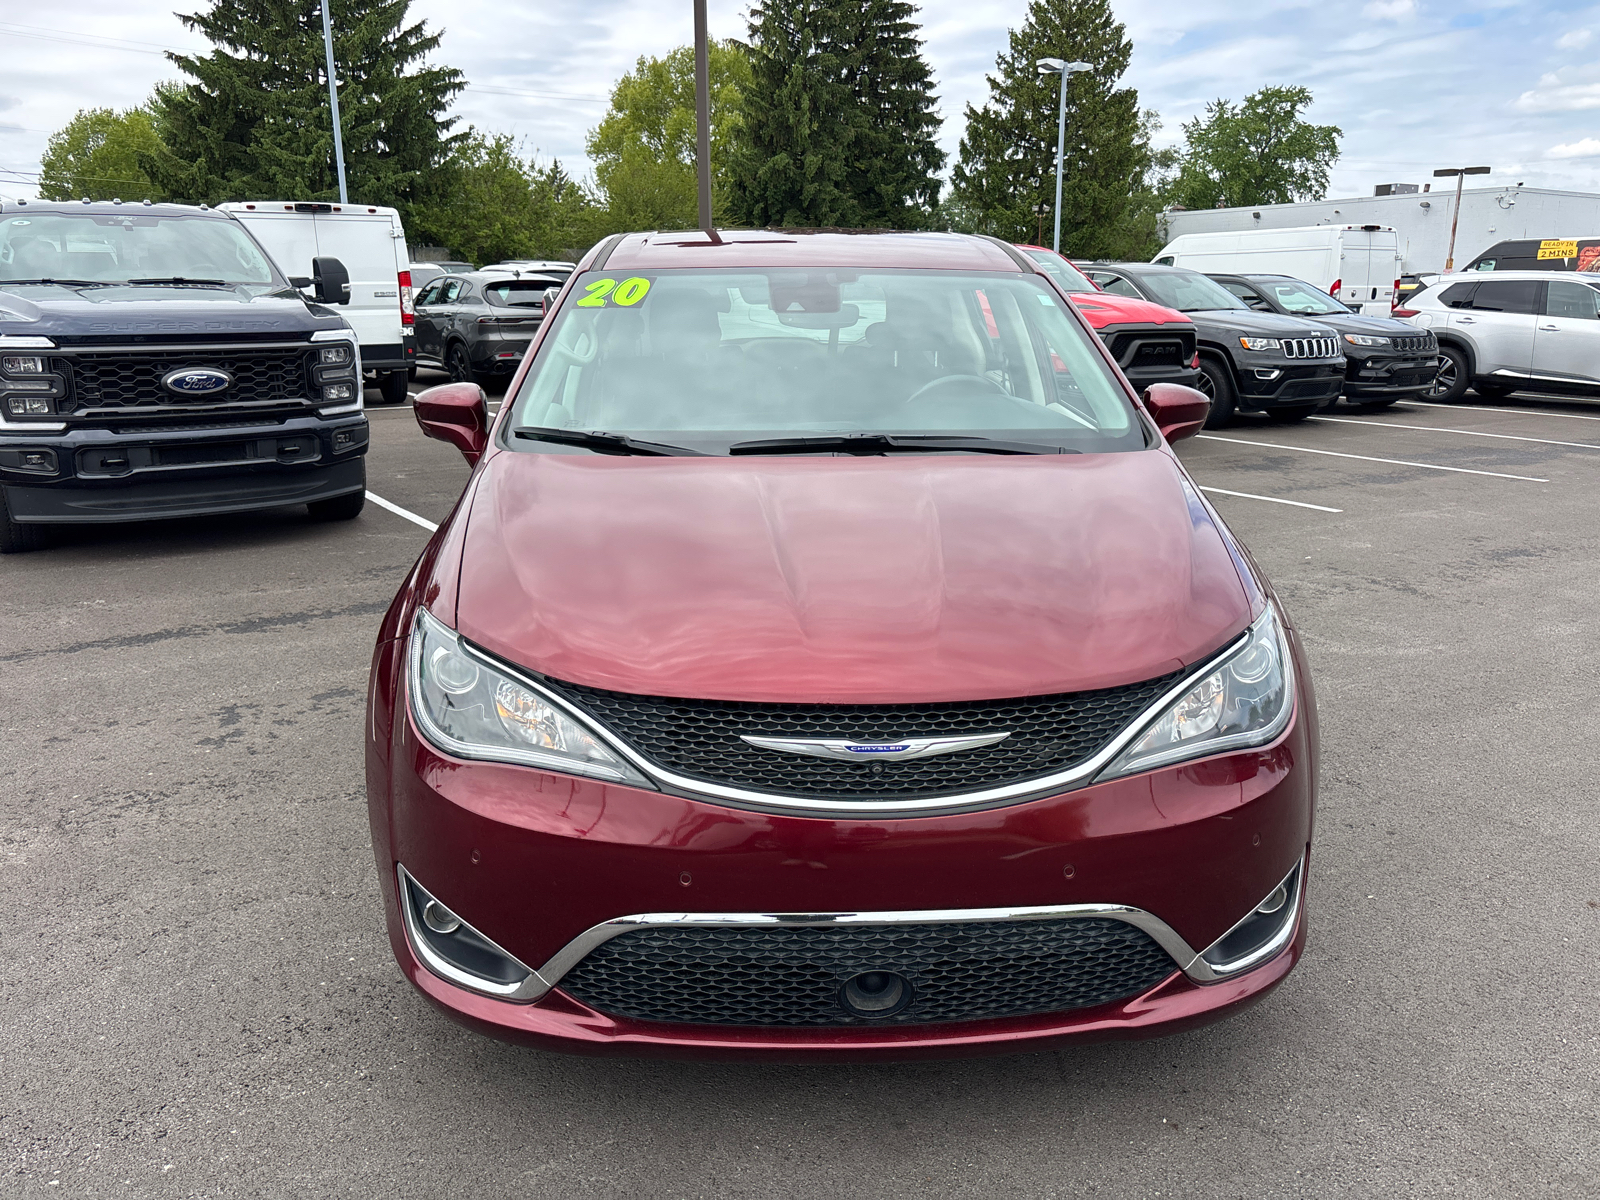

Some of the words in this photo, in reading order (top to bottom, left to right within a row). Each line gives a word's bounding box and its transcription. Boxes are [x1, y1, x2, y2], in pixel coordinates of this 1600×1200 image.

[577, 277, 651, 307] 20
[90, 322, 199, 332] SUPER
[204, 320, 281, 330] DUTY
[1141, 346, 1177, 355] RAM
[182, 375, 216, 389] Ford
